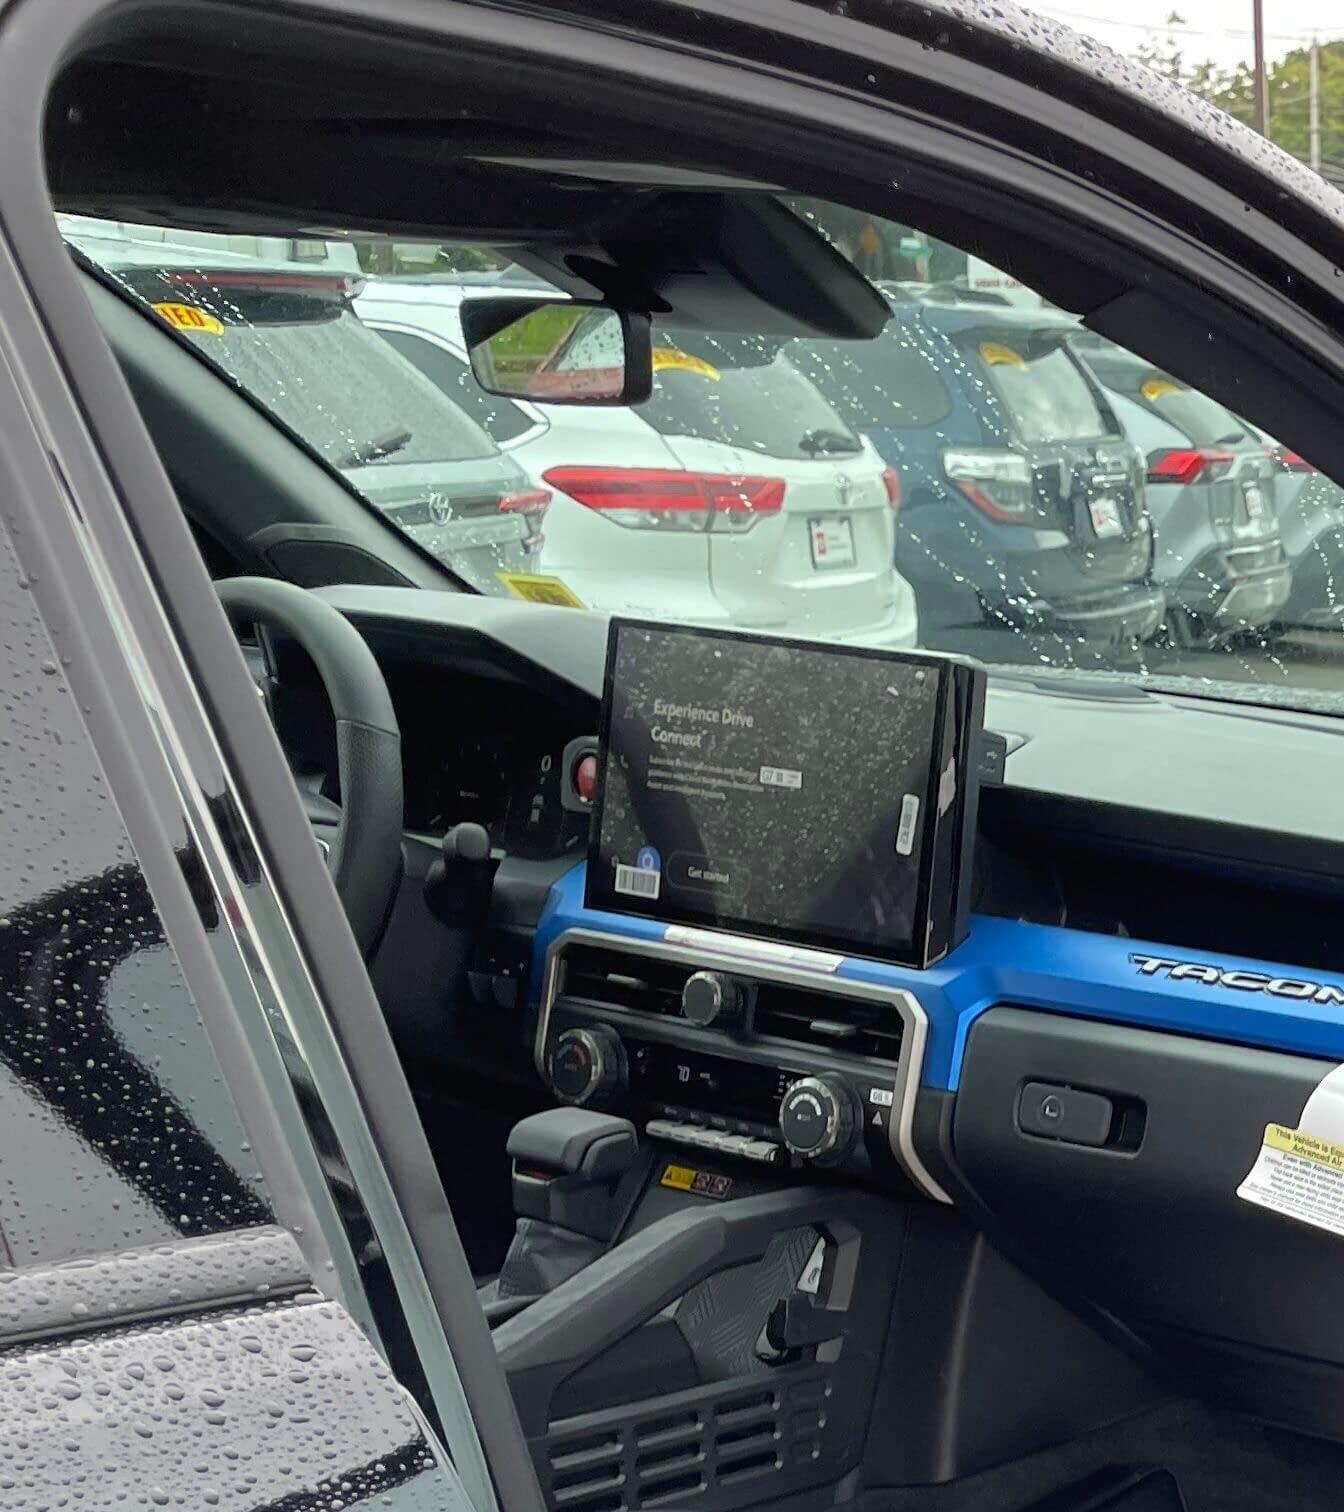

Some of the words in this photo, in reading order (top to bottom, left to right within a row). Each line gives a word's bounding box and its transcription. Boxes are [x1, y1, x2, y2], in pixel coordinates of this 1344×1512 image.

[654, 699, 720, 723] Experience
[722, 708, 754, 728] Drive
[650, 726, 702, 748] Connect
[1275, 1128, 1291, 1141] This
[1293, 1133, 1321, 1150] Vehicle
[1292, 1144, 1331, 1163] Advanced
[1331, 1156, 1342, 1166] Air
